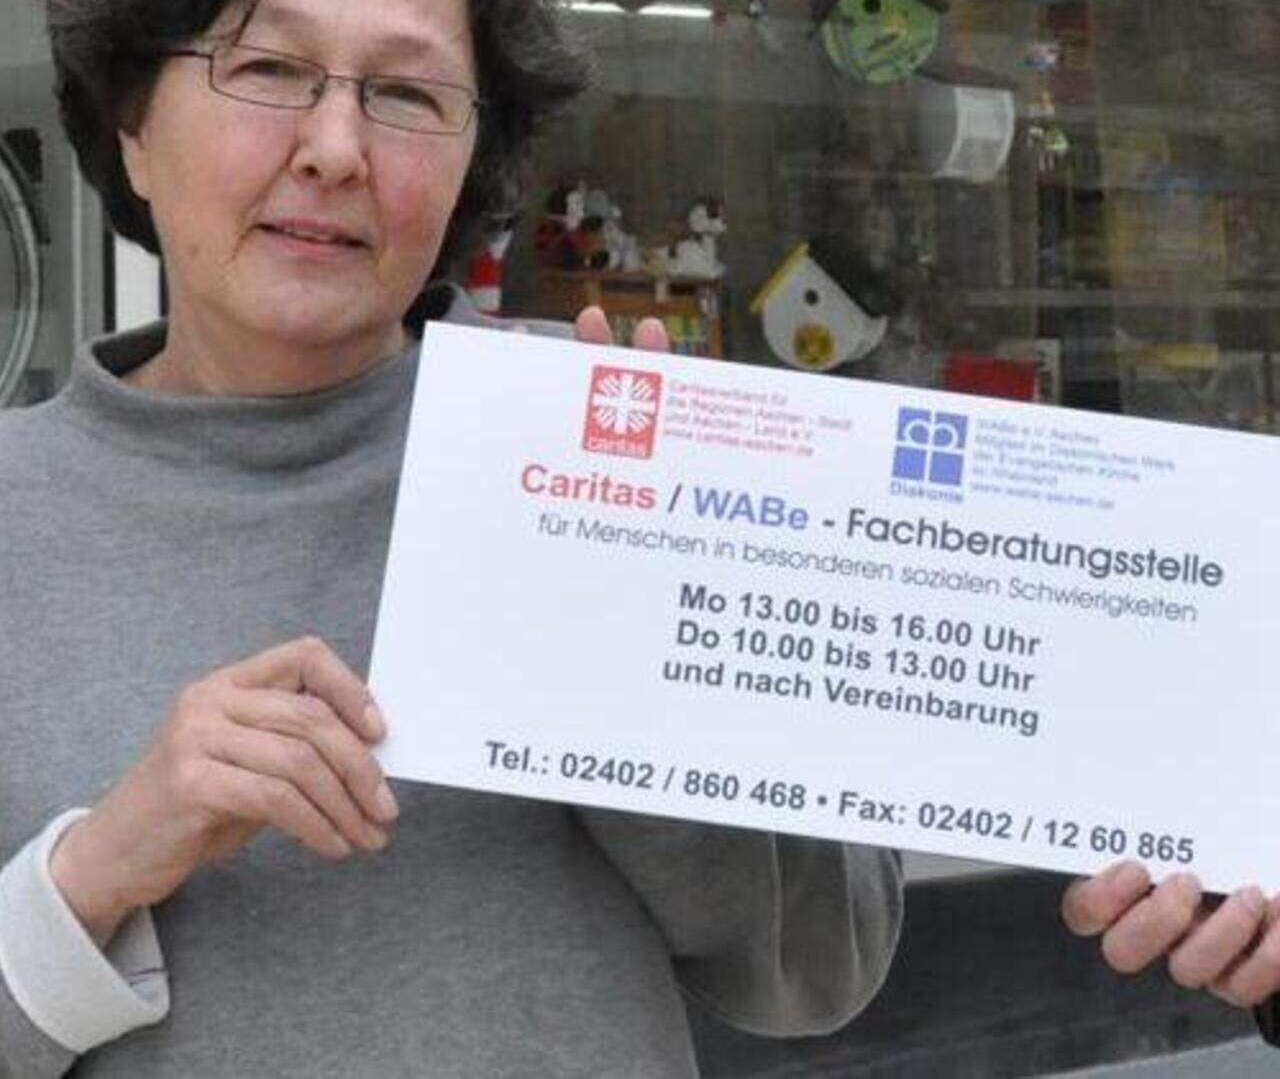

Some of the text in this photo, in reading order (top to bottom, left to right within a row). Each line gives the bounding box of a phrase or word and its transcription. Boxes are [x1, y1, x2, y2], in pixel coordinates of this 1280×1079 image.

[520, 462, 656, 510] Caritas
[666, 482, 683, 513] /
[692, 485, 809, 531] WABe
[845, 507, 1224, 588] Fachberatungsstelle
[889, 481, 964, 504] Diakonie
[537, 511, 1198, 622] für Menschen in besonderen sozialen Schwierigkeiten
[675, 618, 1035, 692] Do 10.00 bis 13.00 Uhr
[678, 582, 1041, 656] Mo 13.00 bis 16.00 Uhr
[661, 660, 1039, 737] und nach Vereinbarung
[484, 739, 549, 775] Tel.:
[559, 751, 655, 789] 02402
[661, 765, 676, 792] /
[682, 768, 740, 801] 860
[748, 778, 807, 811] 468
[837, 789, 906, 825] Fax:
[916, 801, 1013, 839] 02402
[1019, 815, 1034, 842] /
[1043, 818, 1080, 849] 12
[1089, 824, 1127, 855] 60
[1136, 831, 1194, 864] 865
